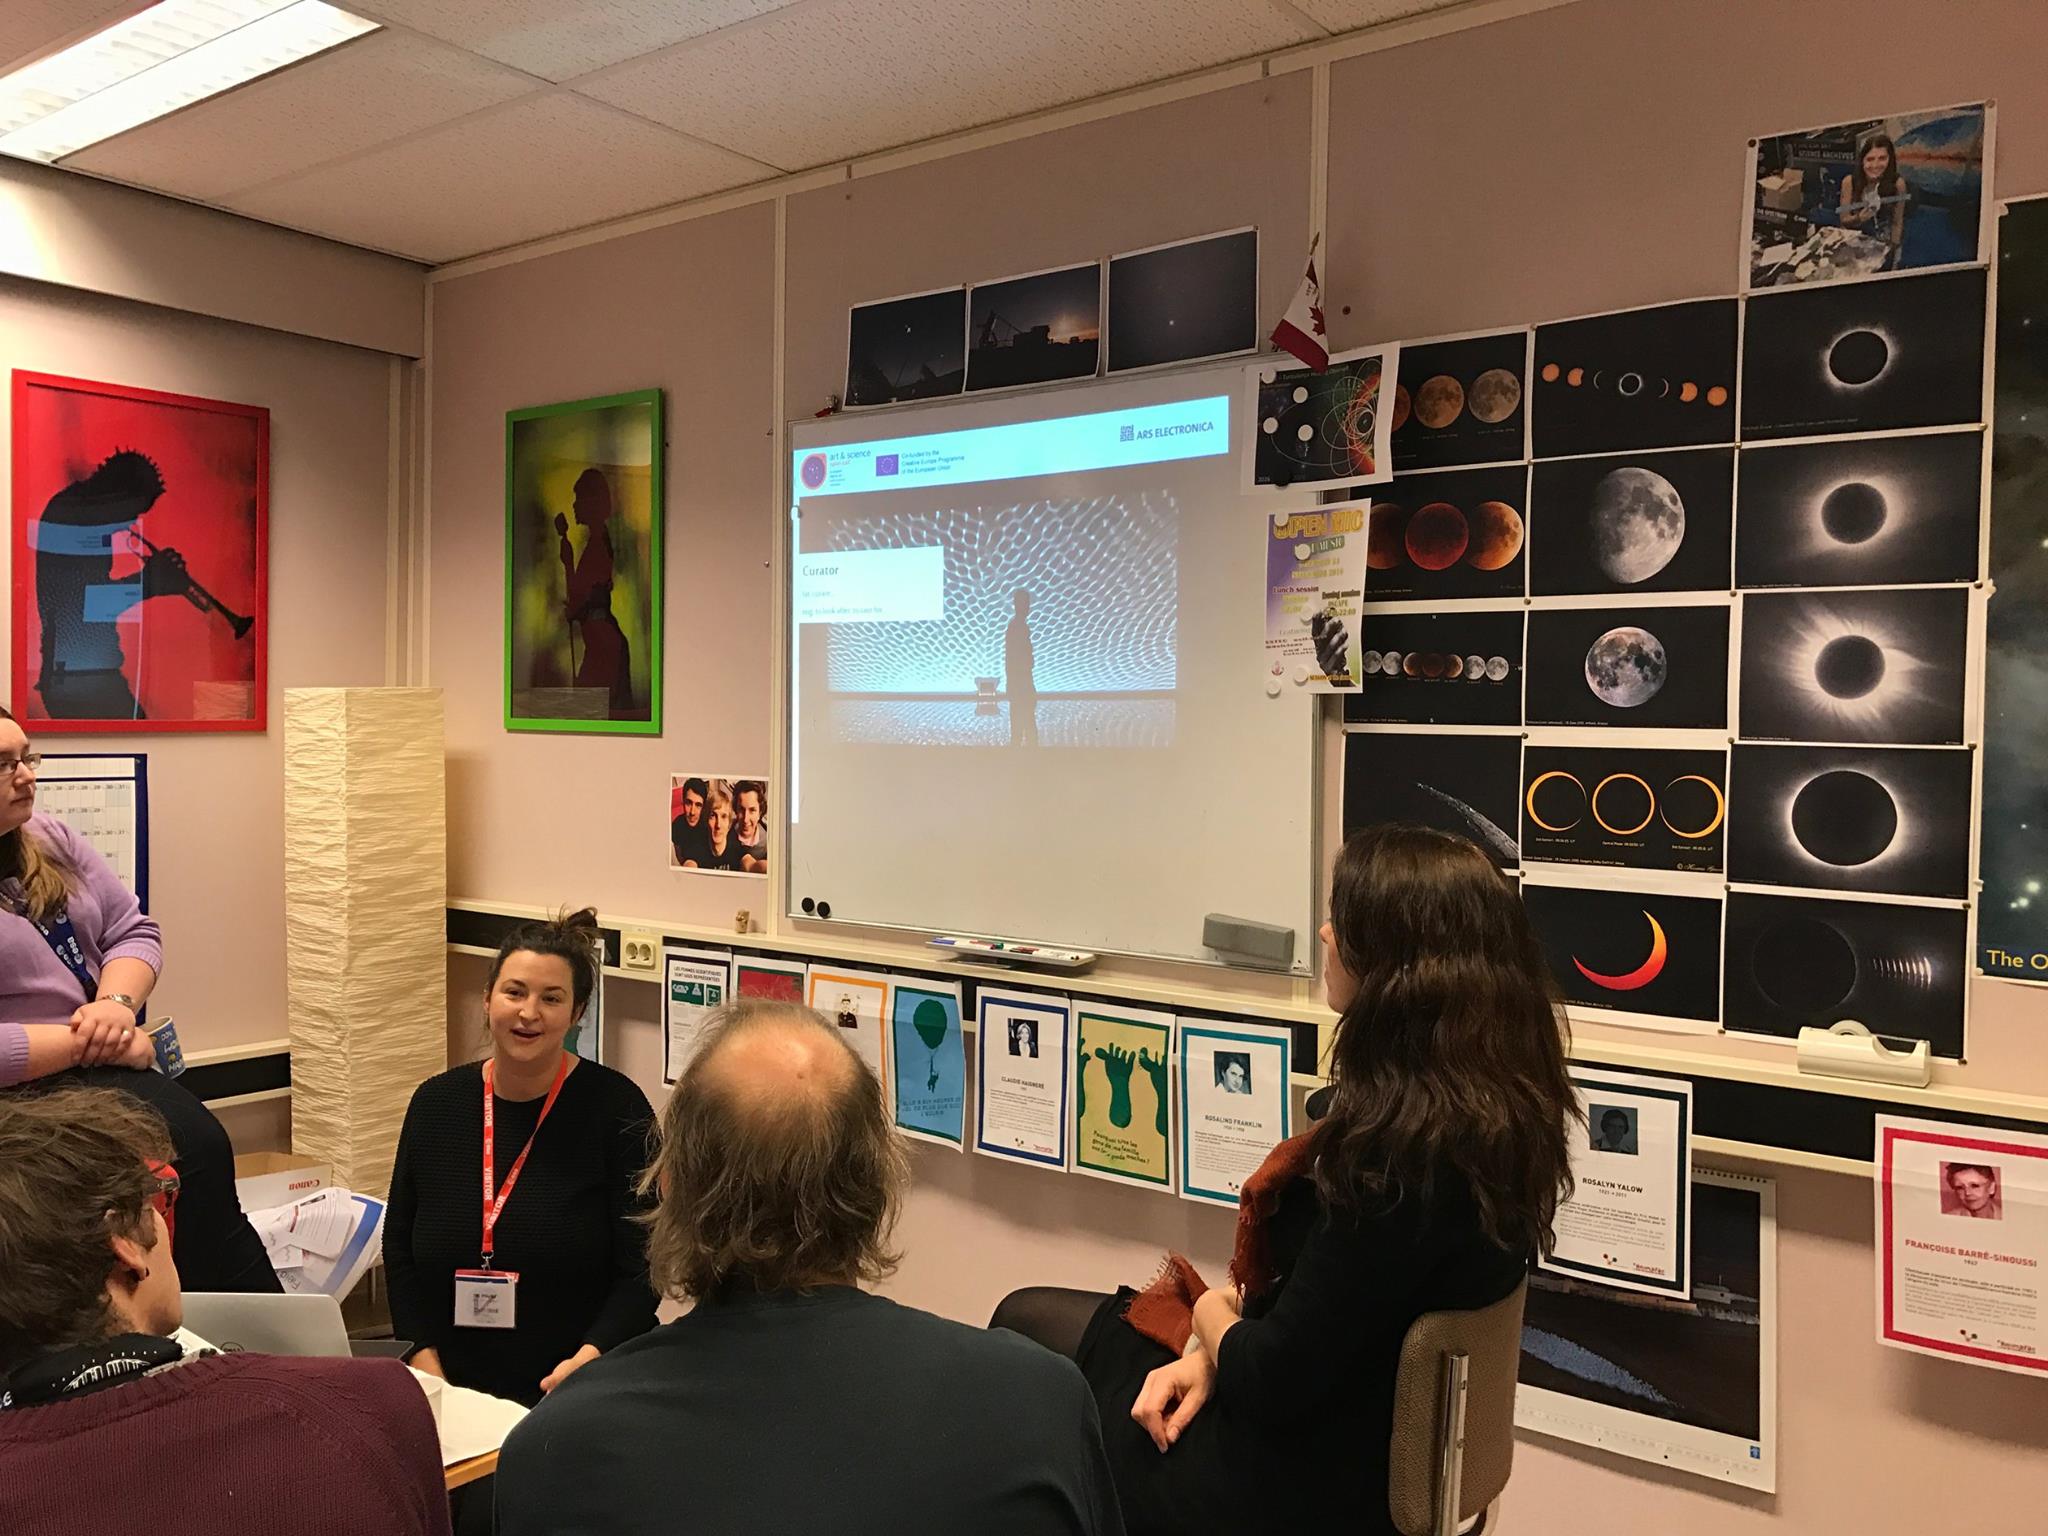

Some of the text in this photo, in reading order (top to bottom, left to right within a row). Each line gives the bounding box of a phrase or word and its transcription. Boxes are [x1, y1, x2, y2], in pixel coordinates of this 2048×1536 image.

[1137, 421, 1214, 441] ARS ELECTRONICA
[847, 450, 872, 460] science
[1331, 509, 1364, 533] MIC
[802, 565, 839, 577] Curator
[1986, 949, 2024, 968] The
[484, 1093, 493, 1127] VISITOR
[1204, 1114, 1263, 1128] ROSALIND FRANKLIN
[288, 1179, 320, 1191] Canon
[484, 1167, 493, 1201] VISITOR
[1582, 1177, 1643, 1194] ROSALYN YALOW
[485, 1195, 506, 1230] VISITOR
[1904, 1239, 2038, 1267] FRANÇOISE BARRÉ-SINOUSSI
